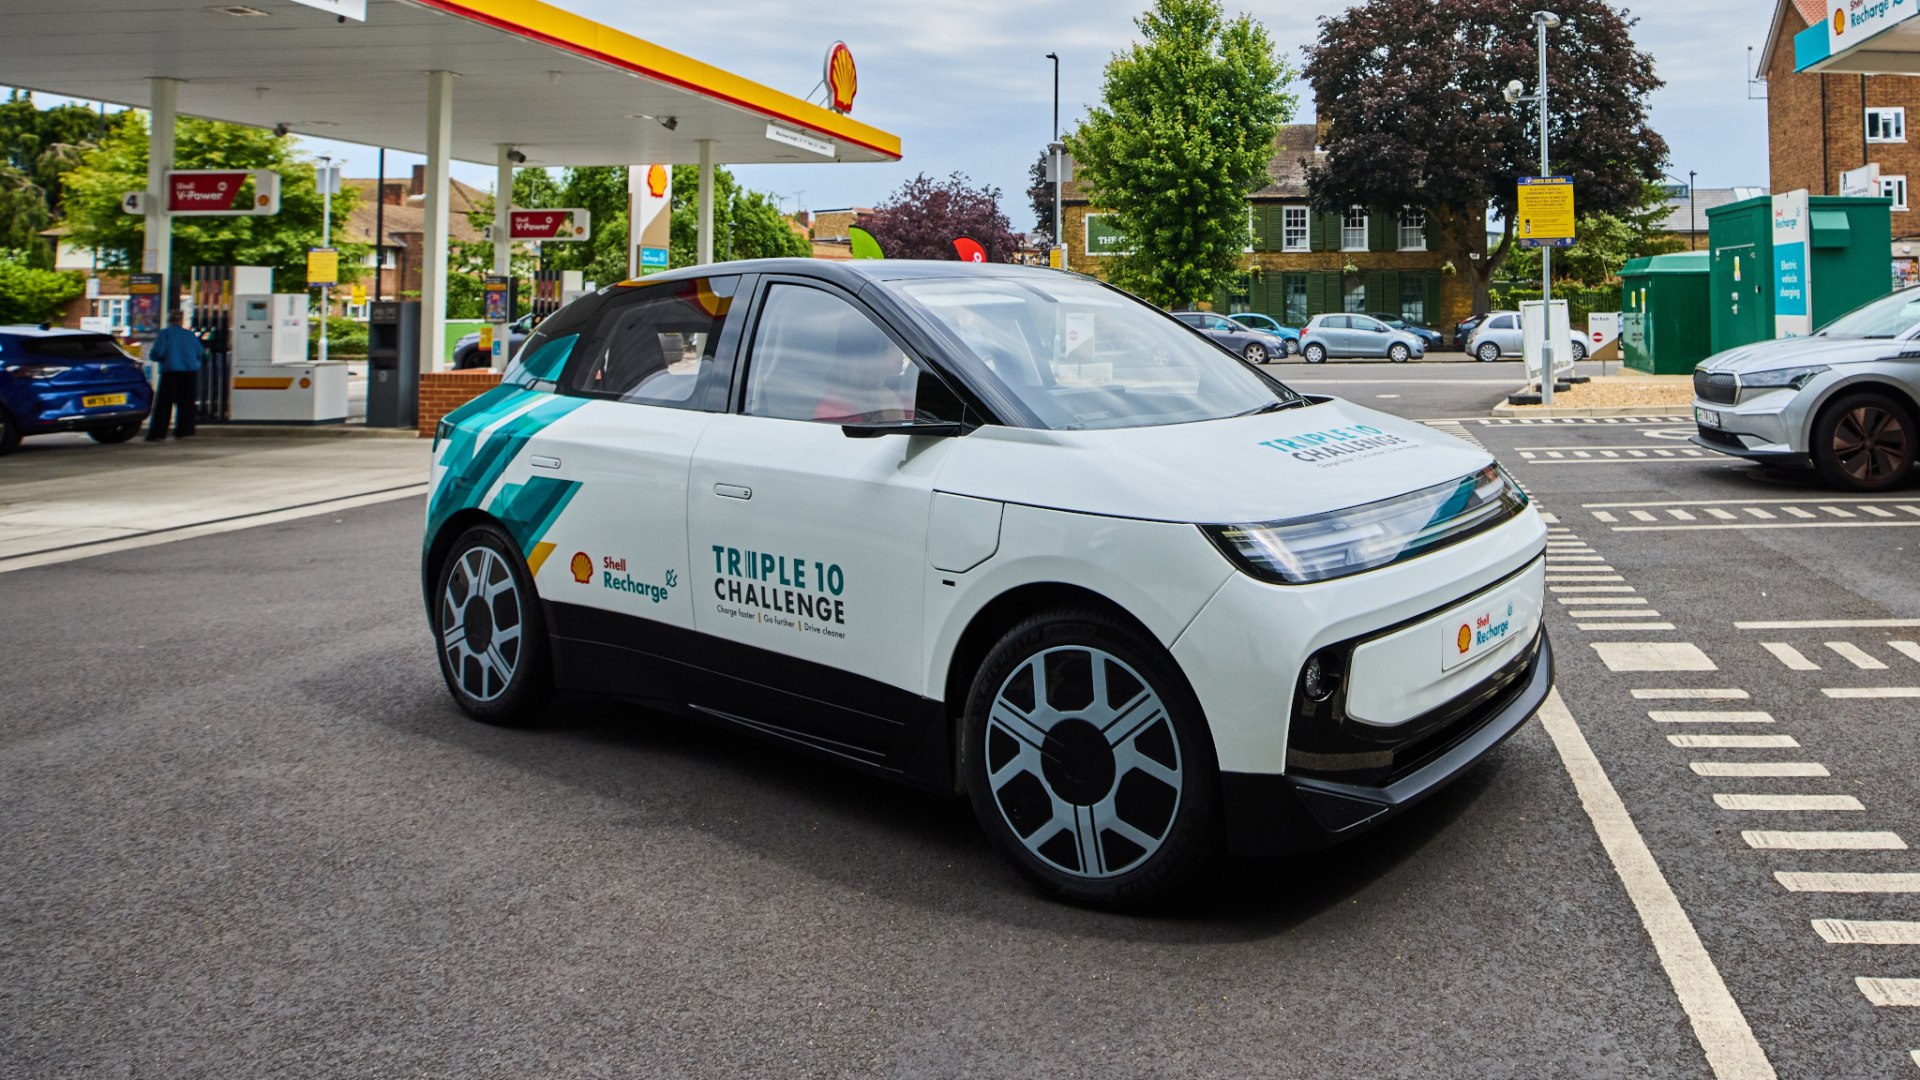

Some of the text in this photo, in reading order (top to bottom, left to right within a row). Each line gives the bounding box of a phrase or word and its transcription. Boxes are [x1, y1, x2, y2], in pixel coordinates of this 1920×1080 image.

[1850, 0, 1890, 28] Recharge
[176, 182, 195, 190] Shell
[126, 195, 138, 209] 4
[176, 191, 224, 201] V-Power
[516, 223, 550, 231] V-Power
[1775, 218, 1797, 230] Recharge
[483, 227, 491, 239] 2
[1780, 259, 1797, 271] Electric
[1781, 273, 1798, 283] vehicle
[1780, 287, 1801, 300] charging
[1257, 427, 1358, 453] TRIPLE
[1291, 434, 1408, 463] CHALLENGE
[603, 556, 626, 572] Shell
[712, 545, 844, 596] TRIPLE 10
[603, 571, 668, 603] Recharge
[714, 577, 845, 625] CHALLENGE
[716, 604, 846, 639] Charge faster Go further Drive cleaner
[1477, 613, 1489, 629] Shell
[1477, 620, 1508, 645] Recharge
